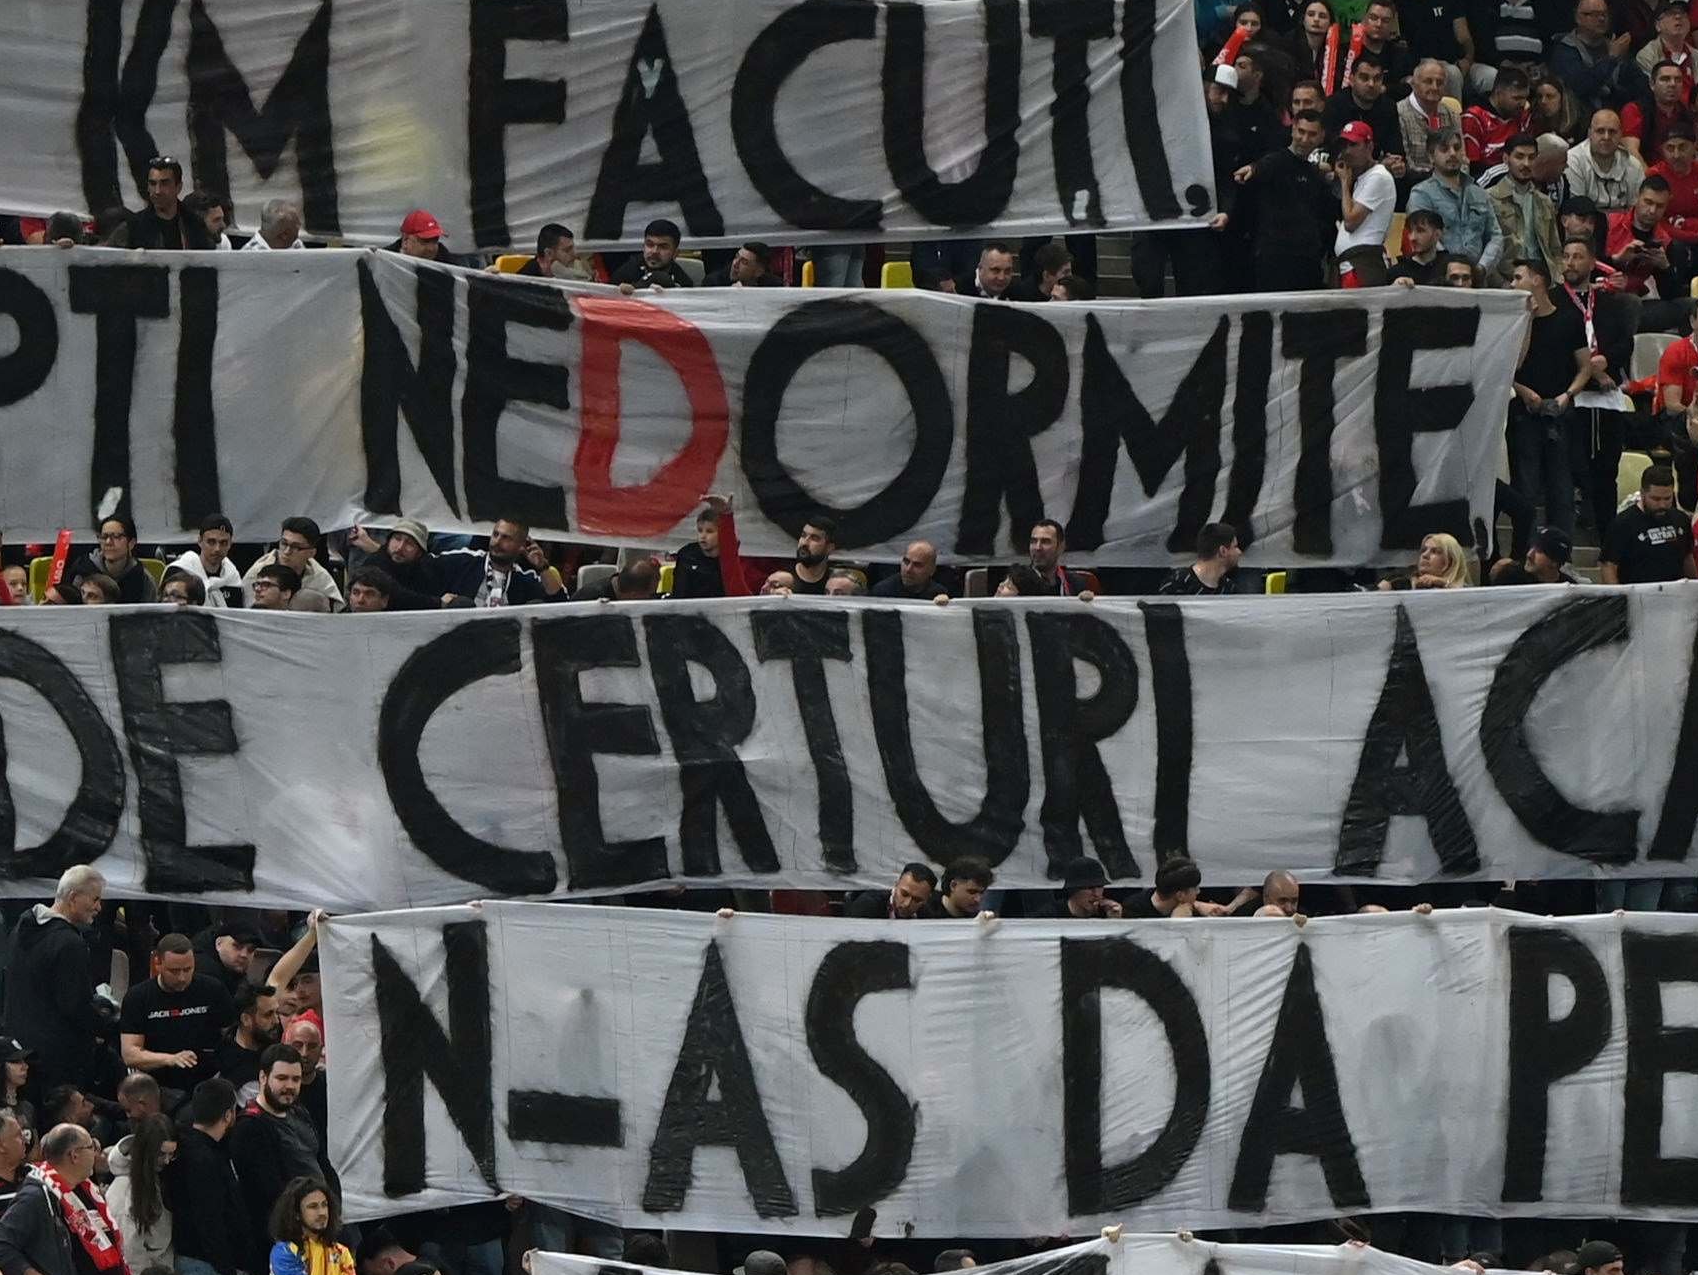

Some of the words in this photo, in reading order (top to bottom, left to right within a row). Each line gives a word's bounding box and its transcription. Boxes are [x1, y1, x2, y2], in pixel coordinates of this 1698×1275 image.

[375, 601, 1194, 895] CERTURI
[180, 1006, 208, 1017] JONES
[1058, 933, 1372, 1217] DA
